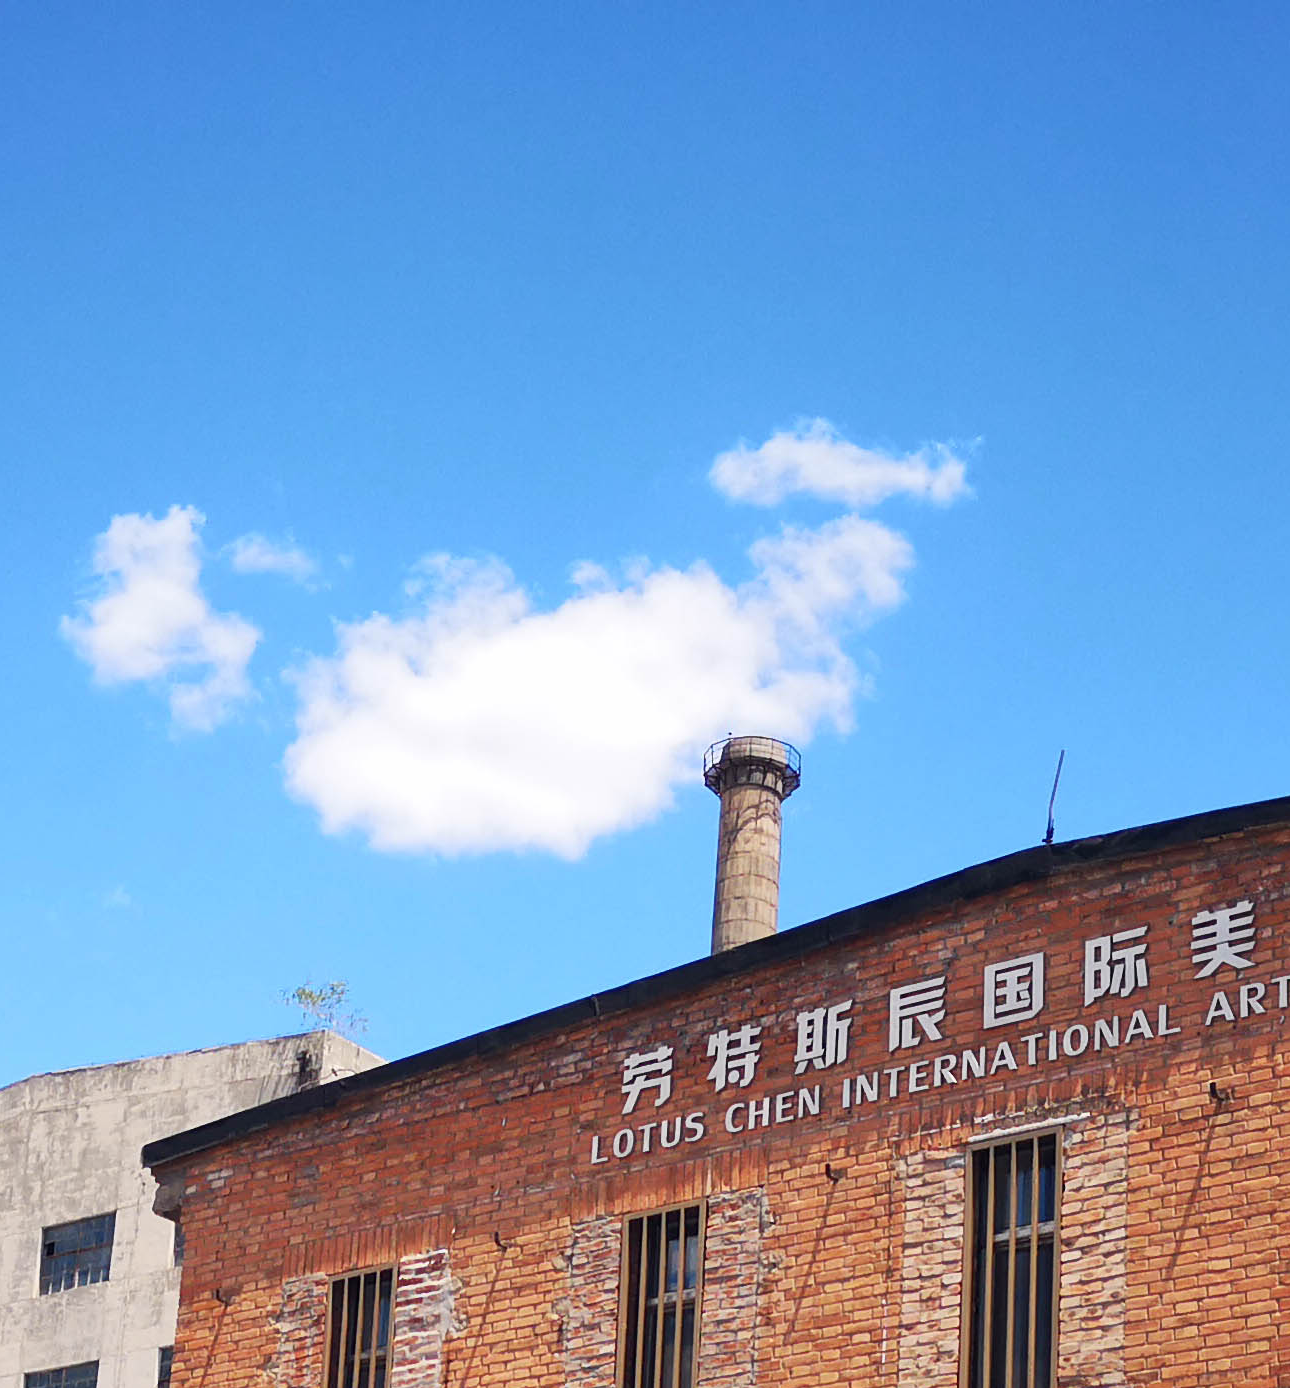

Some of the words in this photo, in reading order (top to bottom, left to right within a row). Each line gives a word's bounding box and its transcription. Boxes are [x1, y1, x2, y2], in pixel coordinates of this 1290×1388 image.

[589, 1111, 705, 1166] LOTUS
[725, 1085, 821, 1134] CHEN
[841, 1003, 1181, 1109] INTERNATIONAL
